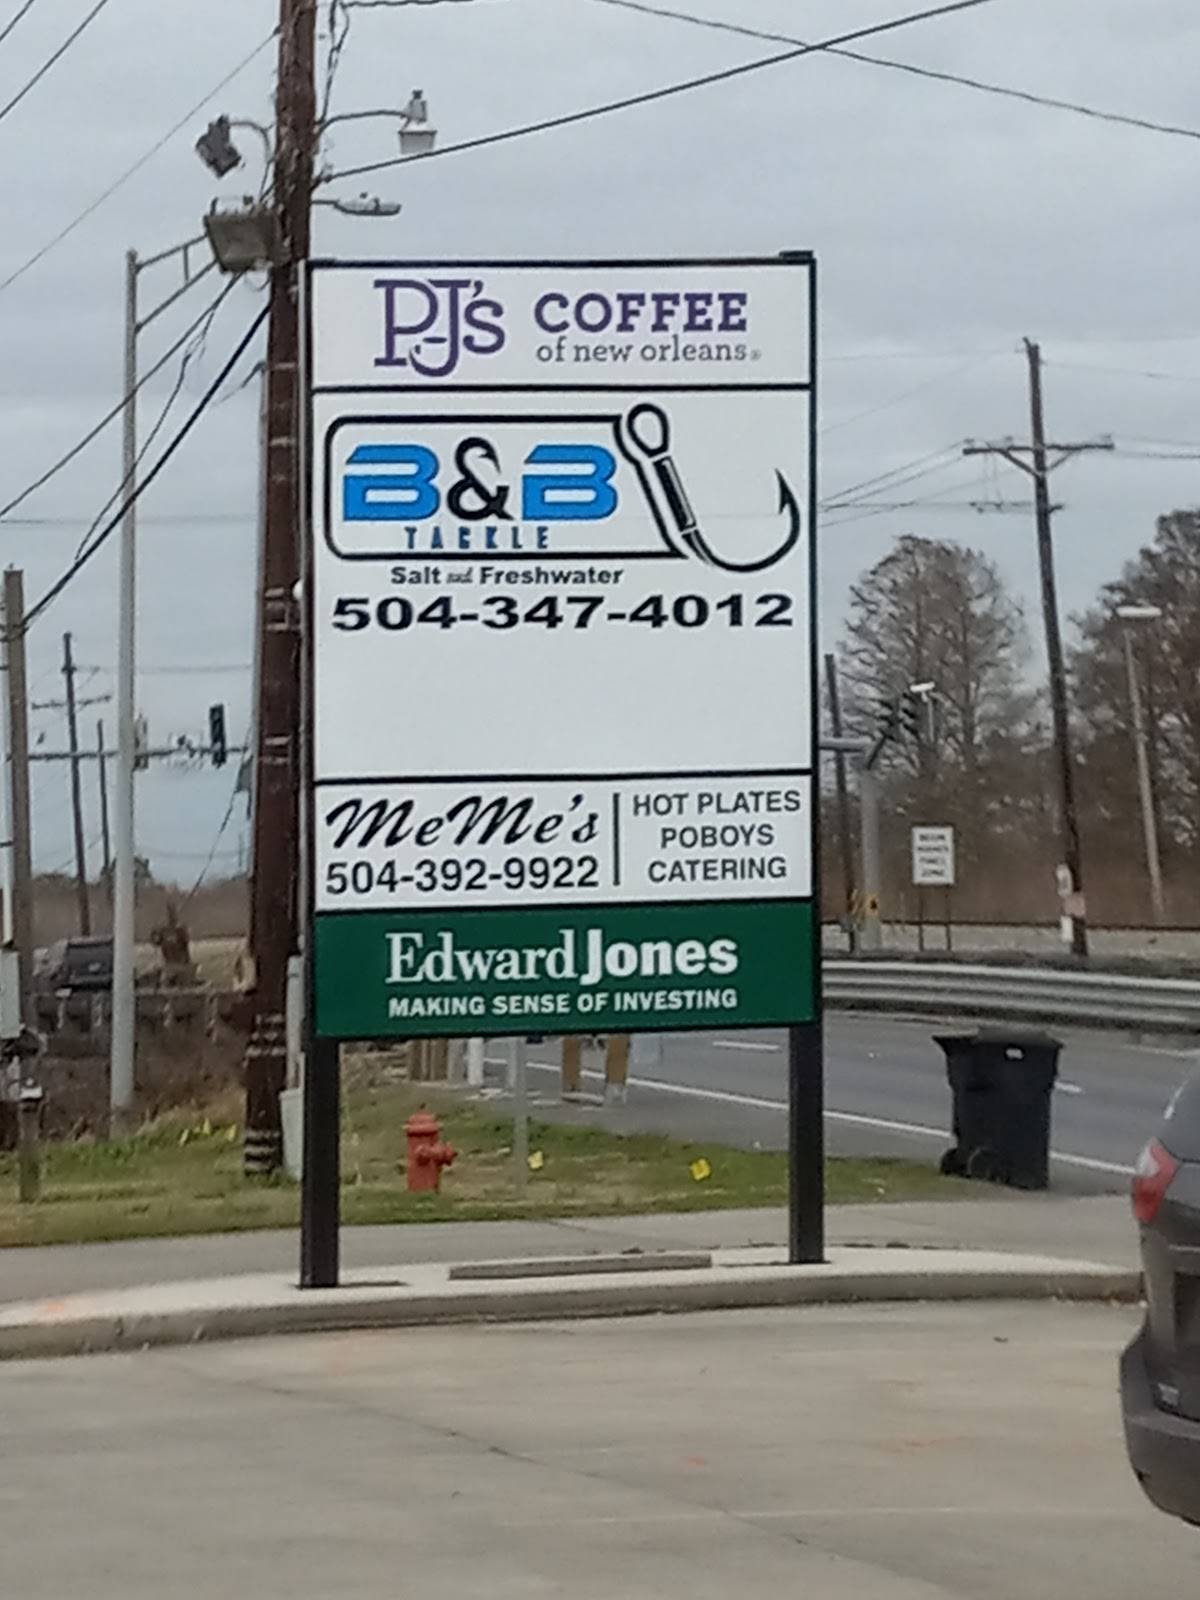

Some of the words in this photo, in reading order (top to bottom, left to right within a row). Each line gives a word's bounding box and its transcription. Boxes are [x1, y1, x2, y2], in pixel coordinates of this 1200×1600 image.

[374, 279, 506, 377] PJ's
[534, 292, 748, 333] COFFEE
[536, 335, 567, 363] of
[573, 346, 632, 362] new
[640, 336, 747, 362] orleans
[343, 437, 619, 522] B&B
[405, 526, 550, 549] TACKLE
[391, 566, 442, 584] Salt
[479, 566, 623, 584] Freshwater
[332, 593, 794, 630] 504-347-4012
[633, 793, 689, 816] HOT
[697, 790, 801, 814] PLATES
[325, 794, 600, 850] MeMe's
[661, 824, 775, 849] POBOYS
[326, 857, 600, 895] 504-392-9922
[648, 857, 787, 883] CATERING
[385, 929, 577, 985] Edward
[580, 928, 738, 986] Jones
[389, 996, 485, 1017] MAKING
[492, 994, 570, 1014] SENSE
[577, 992, 608, 1010] OF
[614, 988, 738, 1009] INVESTING
